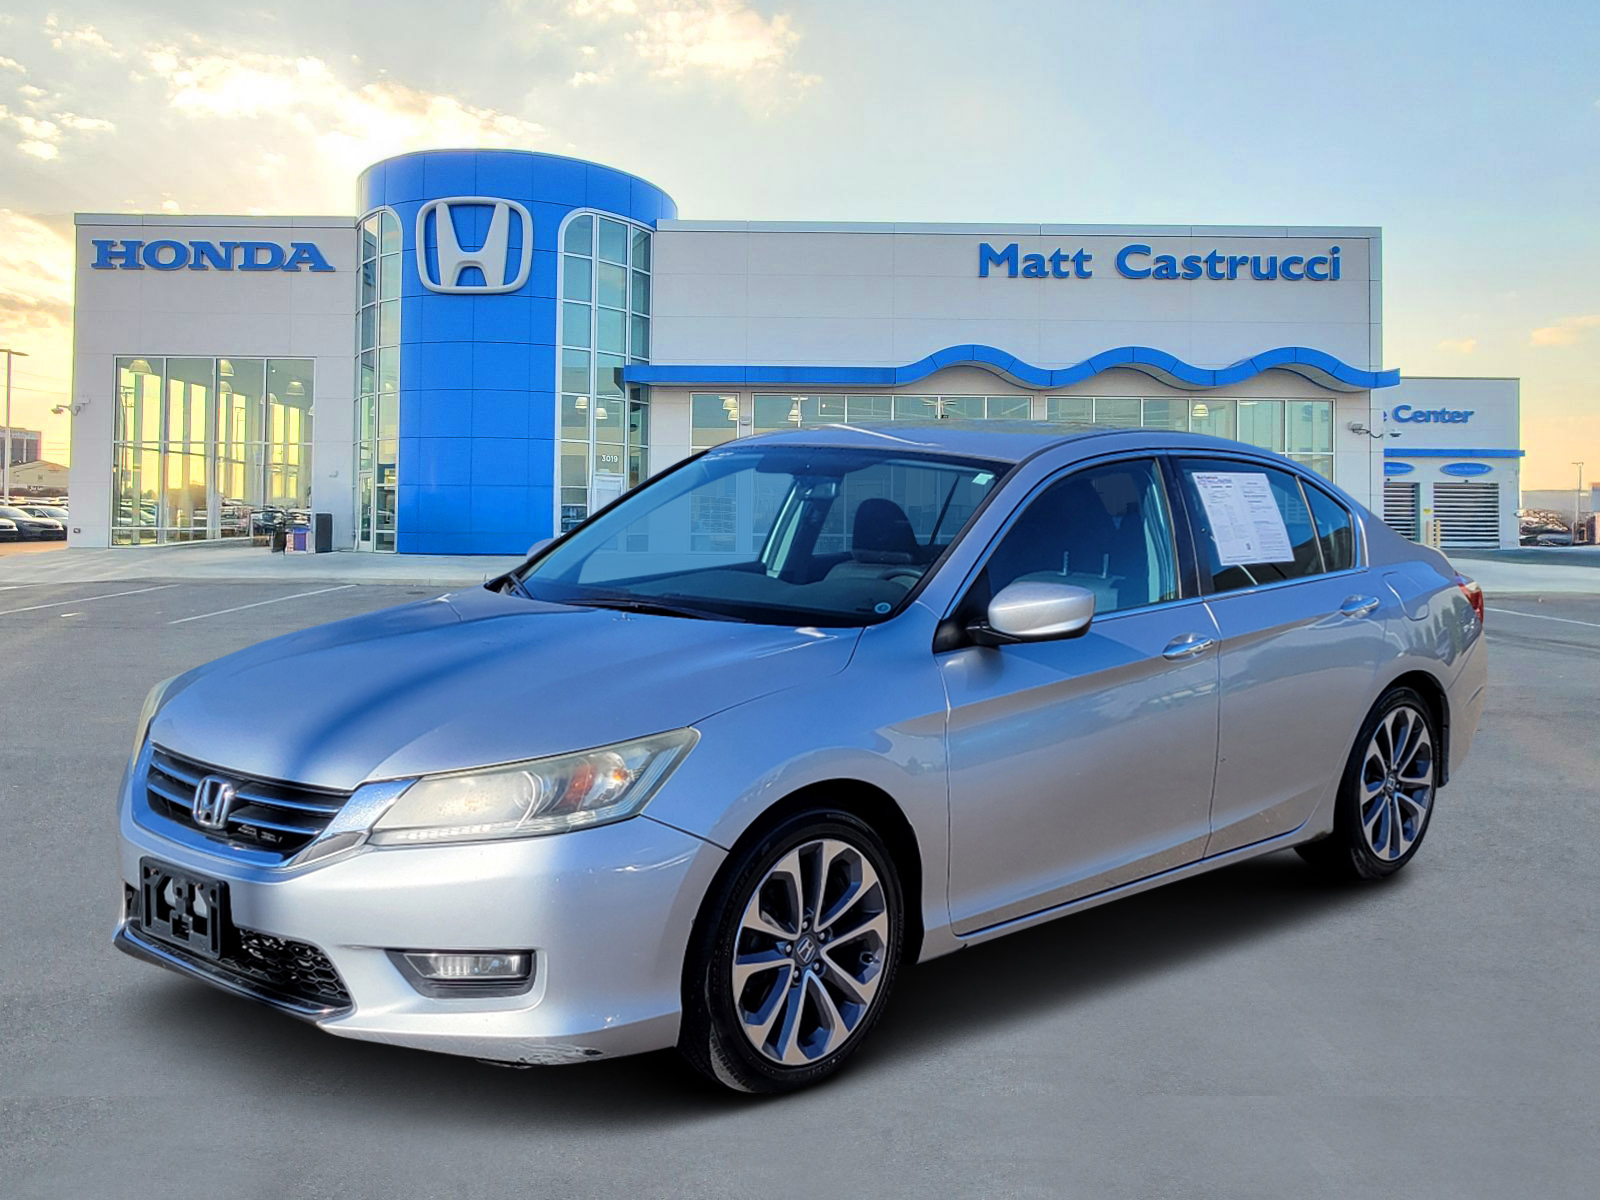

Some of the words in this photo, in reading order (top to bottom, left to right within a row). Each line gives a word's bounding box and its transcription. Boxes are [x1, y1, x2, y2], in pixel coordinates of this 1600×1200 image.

[91, 239, 336, 272] HONDA
[978, 242, 1092, 279] Matt
[1115, 244, 1342, 281] Castrucci
[1392, 404, 1474, 423] Center
